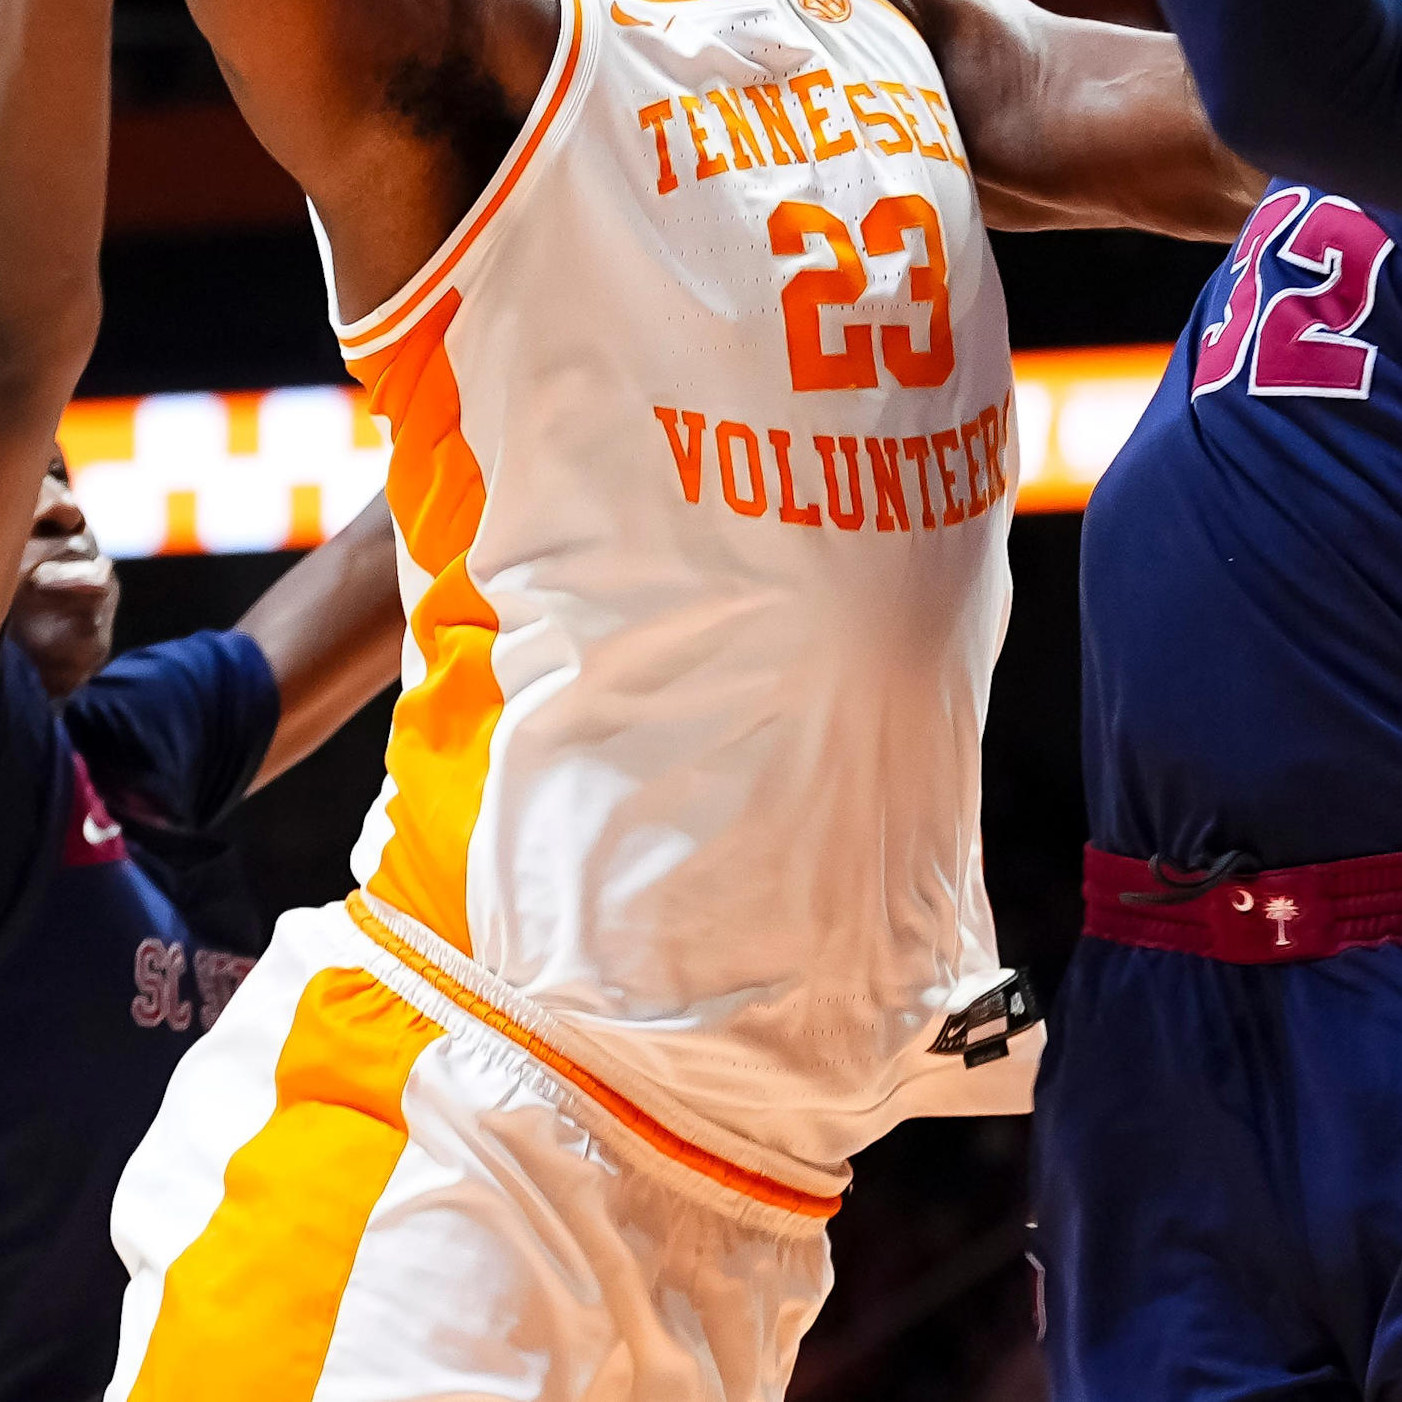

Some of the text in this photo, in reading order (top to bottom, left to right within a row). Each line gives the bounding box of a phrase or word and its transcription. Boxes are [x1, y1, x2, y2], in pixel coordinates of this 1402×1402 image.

[768, 194, 955, 392] 23
[1191, 186, 1396, 401] 32
[654, 390, 1011, 533] VOLUNTEER
